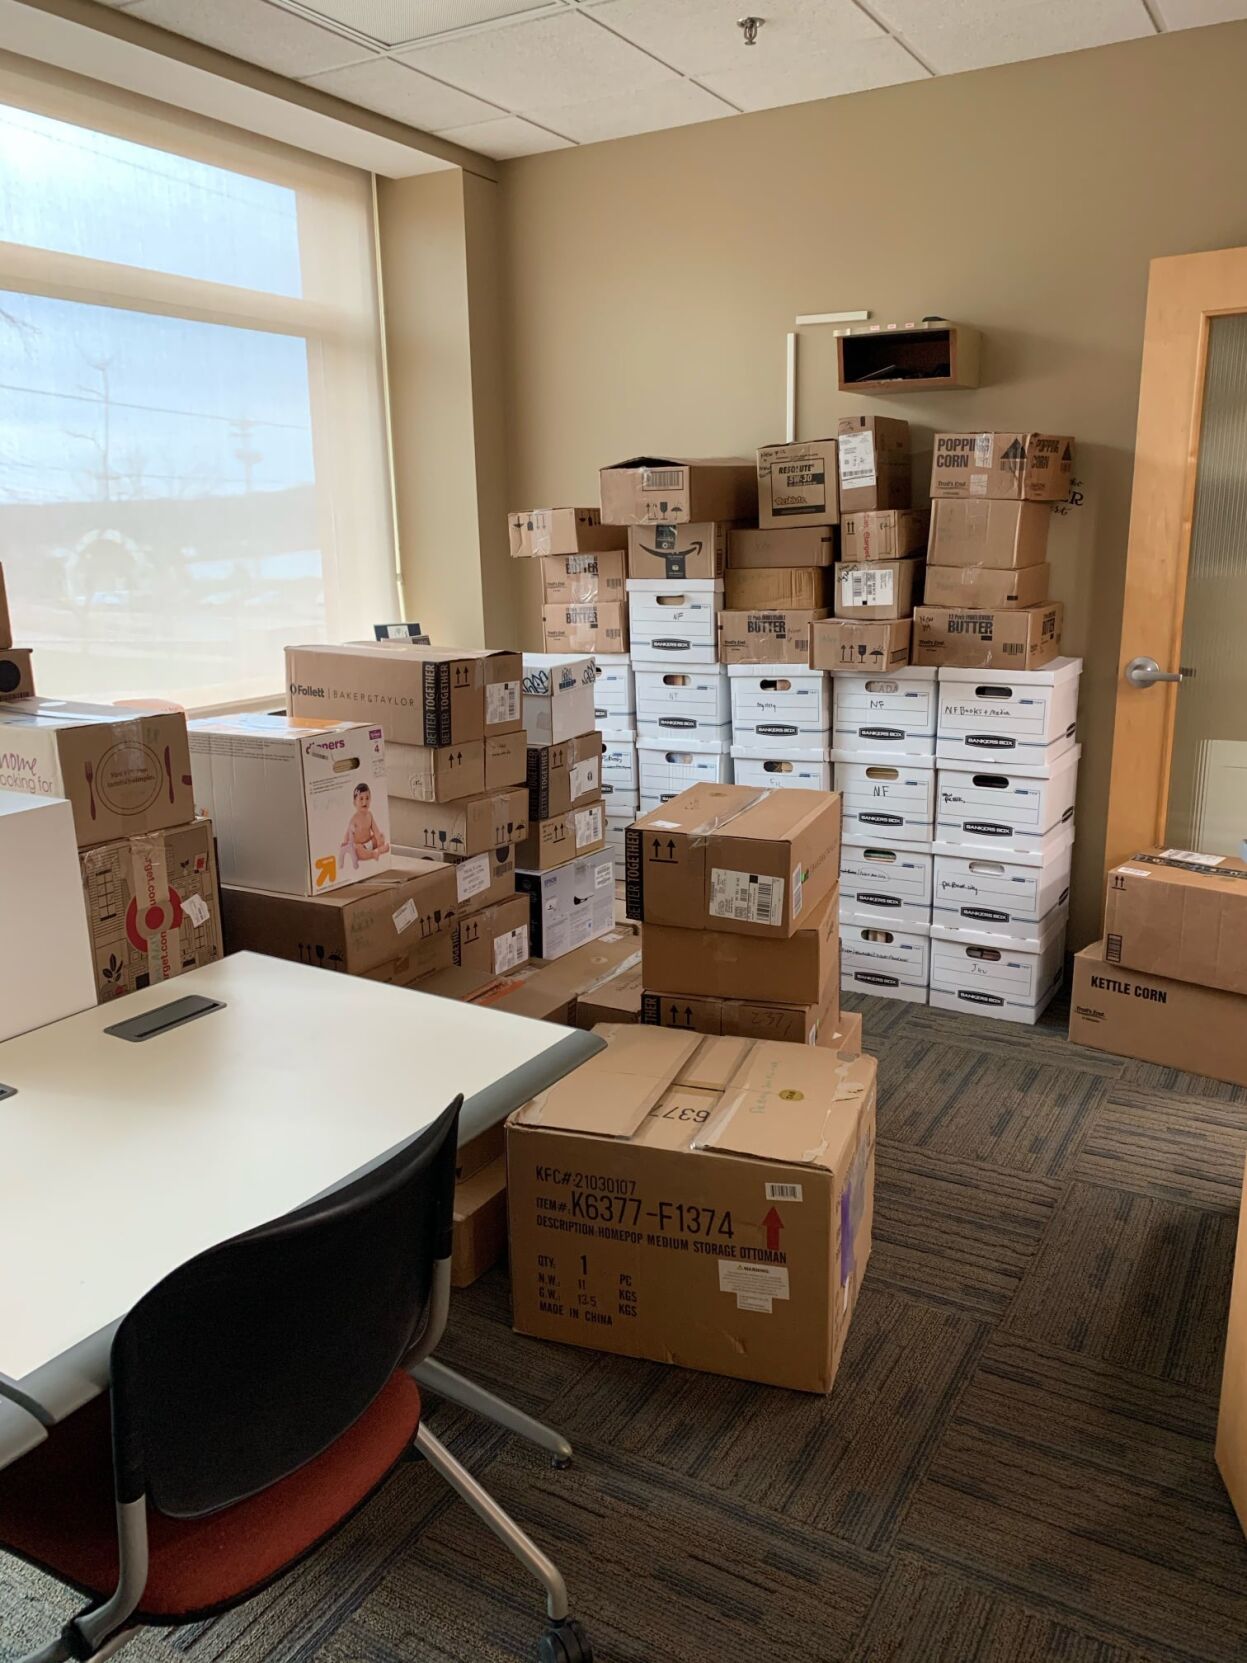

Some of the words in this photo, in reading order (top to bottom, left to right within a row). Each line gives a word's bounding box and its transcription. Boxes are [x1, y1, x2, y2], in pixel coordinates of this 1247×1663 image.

[938, 438, 979, 452] POPPI
[937, 454, 969, 468] CORN
[566, 562, 599, 574] BUER
[747, 620, 786, 633] BUTTER
[947, 620, 993, 635] BUTTER
[297, 685, 325, 699] Follett
[425, 663, 436, 714] TOGETHER
[440, 664, 450, 715] TOGETHER
[870, 700, 885, 709] NF
[944, 705, 959, 715] NF
[425, 715, 436, 746] BETTER
[440, 716, 450, 744] BETTER
[541, 750, 549, 790] TOGETHER
[0, 773, 36, 794] ooking
[37, 776, 53, 793] for
[873, 785, 889, 797] NF
[626, 831, 640, 882] TOGETHER
[627, 885, 640, 919] BETTER
[859, 895, 886, 903] BANKERS
[963, 909, 992, 917] BANKERS
[960, 992, 988, 1001] BANKERS
[1091, 975, 1131, 995] KETTLE
[1134, 985, 1167, 1004] CORN
[599, 1226, 643, 1244] HOMEPOP
[647, 1234, 689, 1250] MEDIUM
[694, 1241, 736, 1257] STORAGE
[740, 1247, 787, 1264] OTTOMAN
[580, 1255, 588, 1275] 1
[619, 1274, 632, 1286] PC
[618, 1289, 637, 1302] KGS
[539, 1301, 564, 1316] MADE
[569, 1307, 579, 1319] IN
[584, 1310, 613, 1326] CHINA
[618, 1304, 637, 1317] KGS
